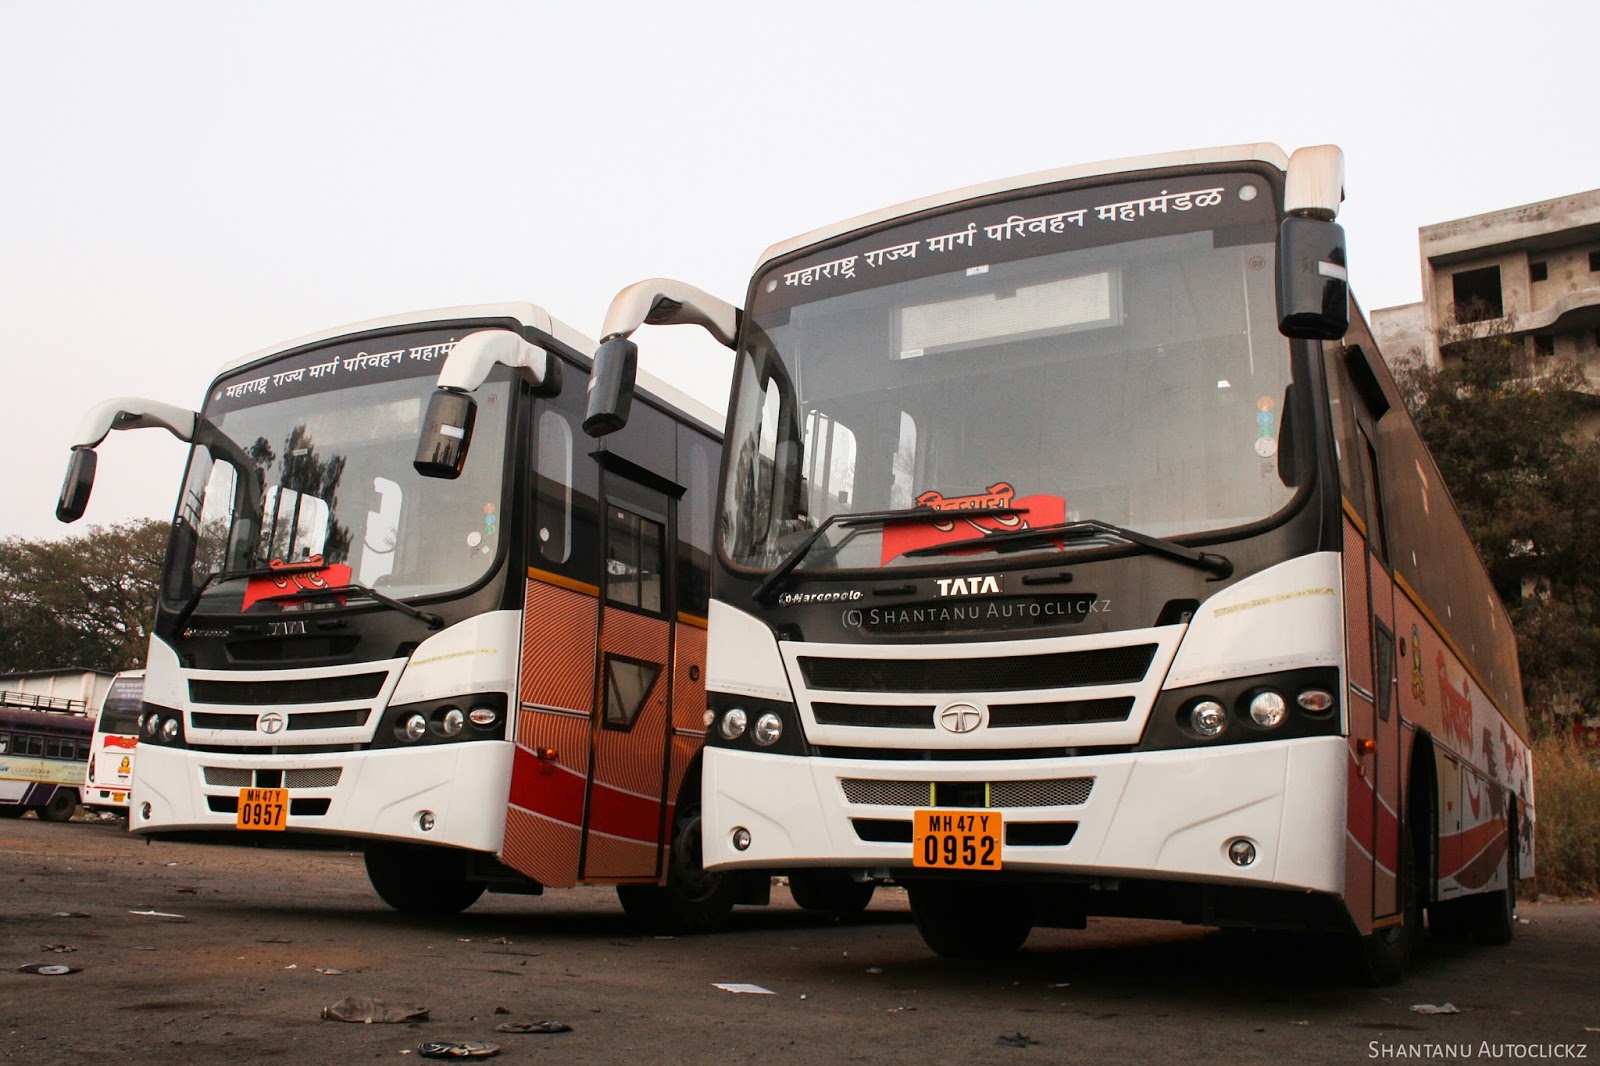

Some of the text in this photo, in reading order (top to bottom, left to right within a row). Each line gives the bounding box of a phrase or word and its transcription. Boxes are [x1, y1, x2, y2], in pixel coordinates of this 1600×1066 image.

[784, 187, 1225, 287] महाराष्ट्र राज्य मार्ग परिवहन महामंडळ
[226, 376, 270, 397] महाराष्ट्र
[273, 368, 305, 387] राज्य
[309, 355, 340, 378] मार्ग
[343, 349, 405, 372] परिवहन
[793, 590, 861, 603] Marcopolo
[937, 576, 999, 596] TATA
[242, 803, 282, 826] 0957
[930, 816, 989, 832] MH 47 Y
[925, 835, 994, 866] 0952
